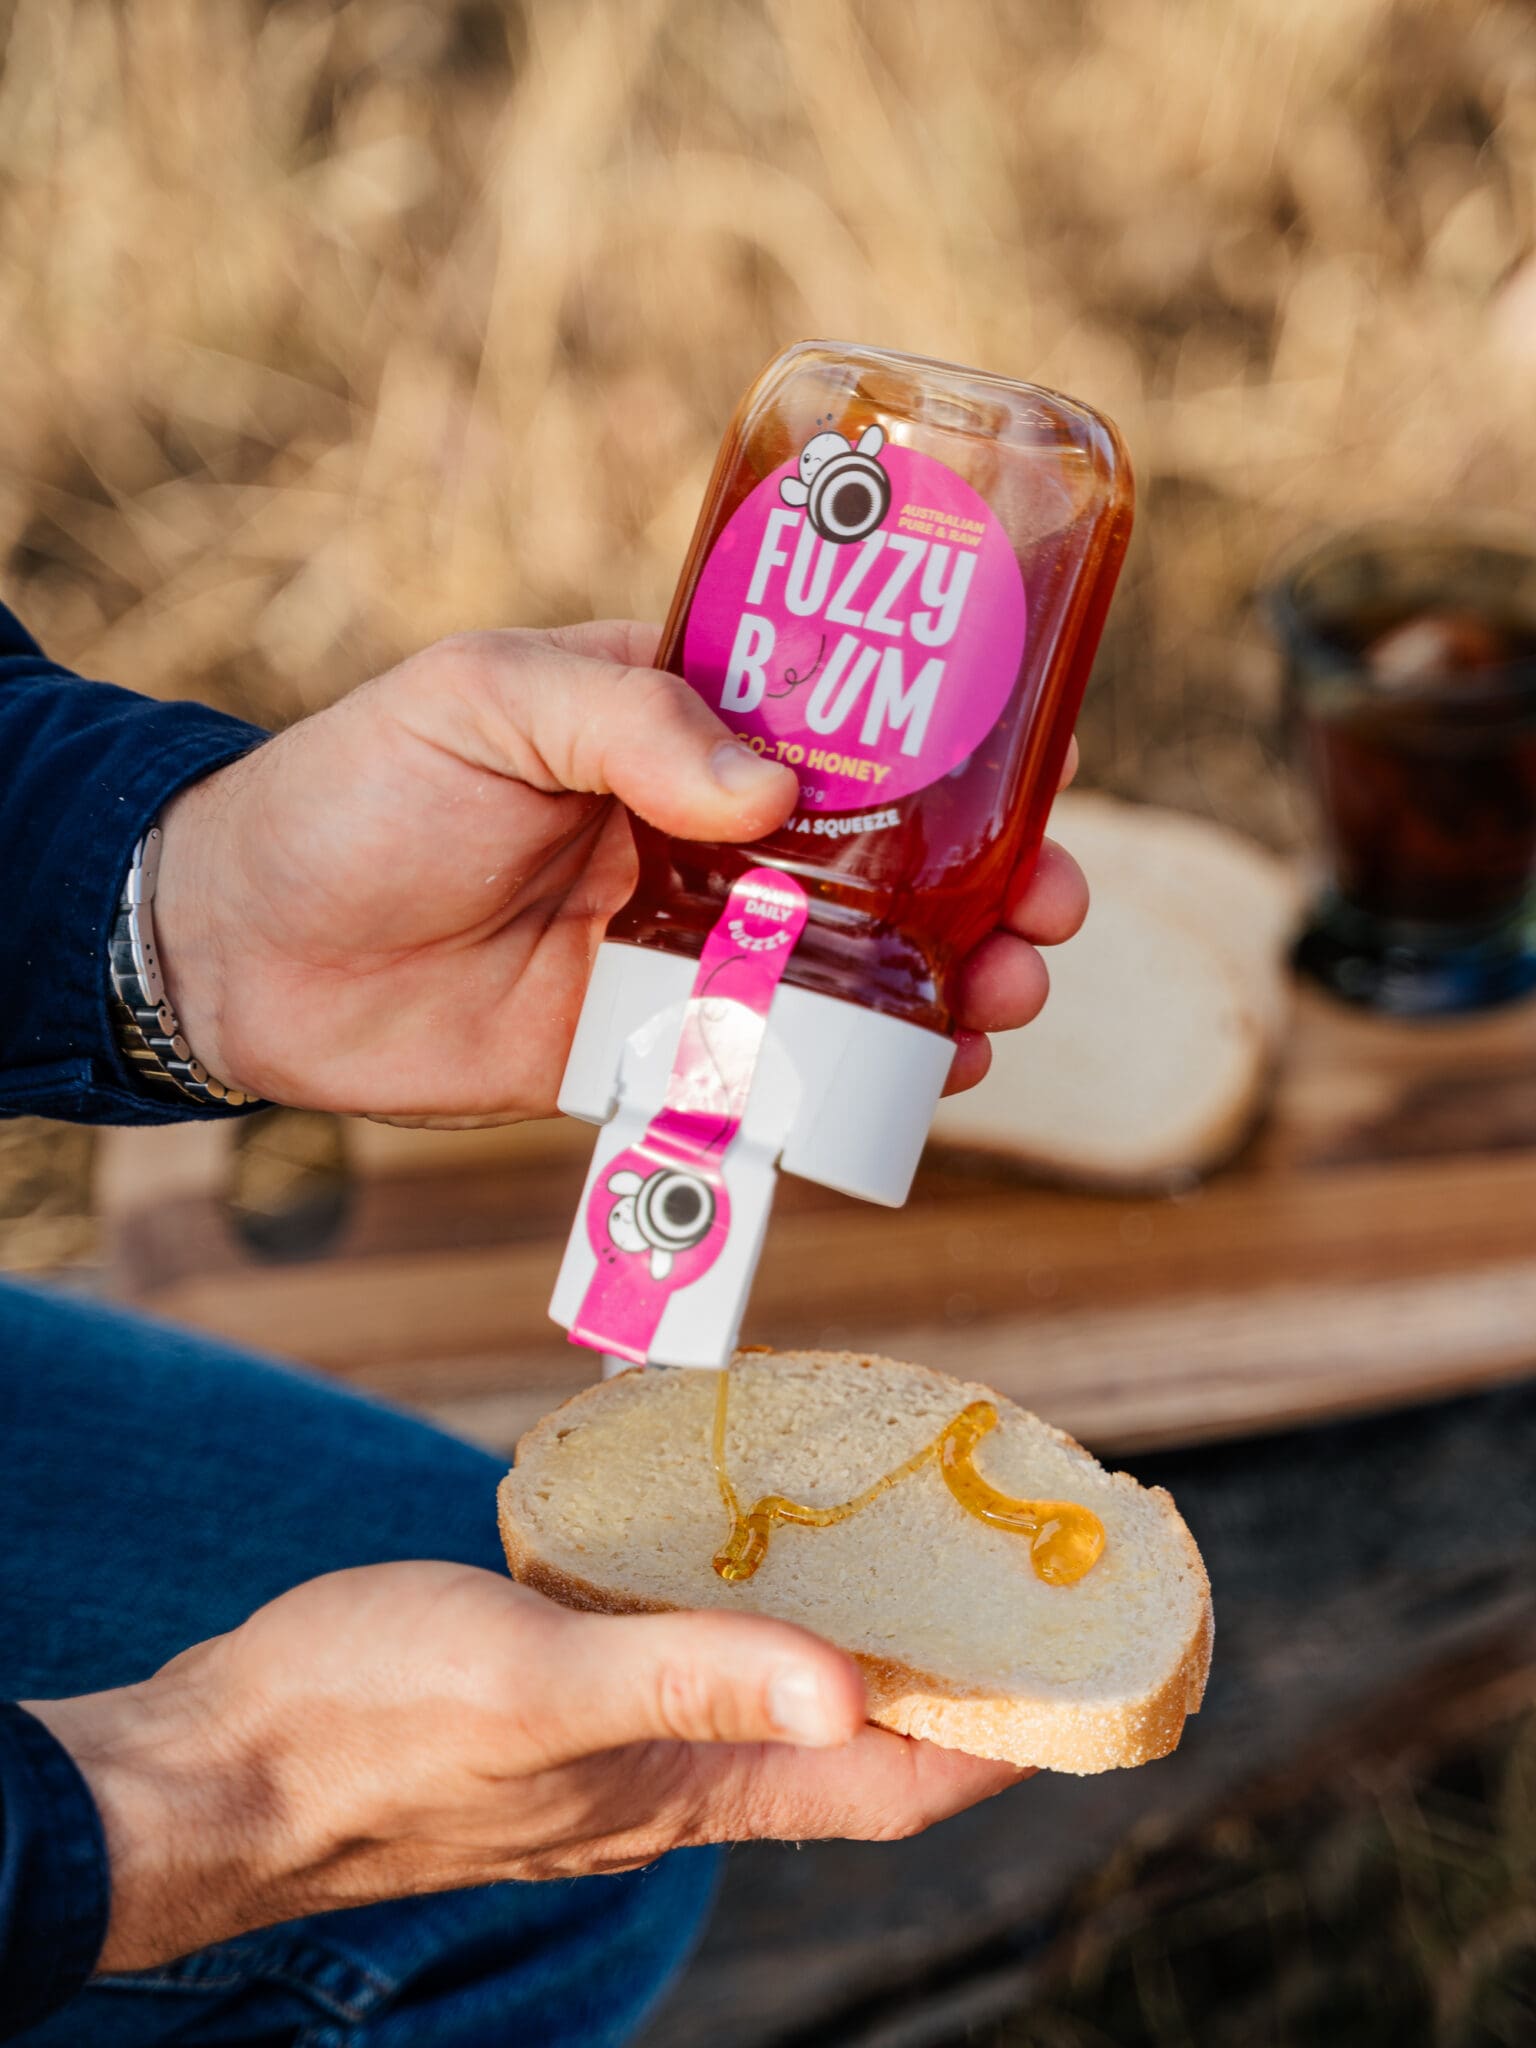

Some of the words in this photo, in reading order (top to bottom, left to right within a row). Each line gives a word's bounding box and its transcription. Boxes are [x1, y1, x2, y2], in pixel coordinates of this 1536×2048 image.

[897, 516, 935, 535] PURE
[935, 526, 946, 539] &
[947, 529, 983, 547] RAW
[900, 503, 986, 534] AUSTRALIAN
[745, 507, 978, 647] FUZZY
[806, 748, 891, 784] HONEY
[795, 817, 811, 834] A
[812, 808, 901, 839] SQUEEZE
[744, 899, 793, 922] DAILY
